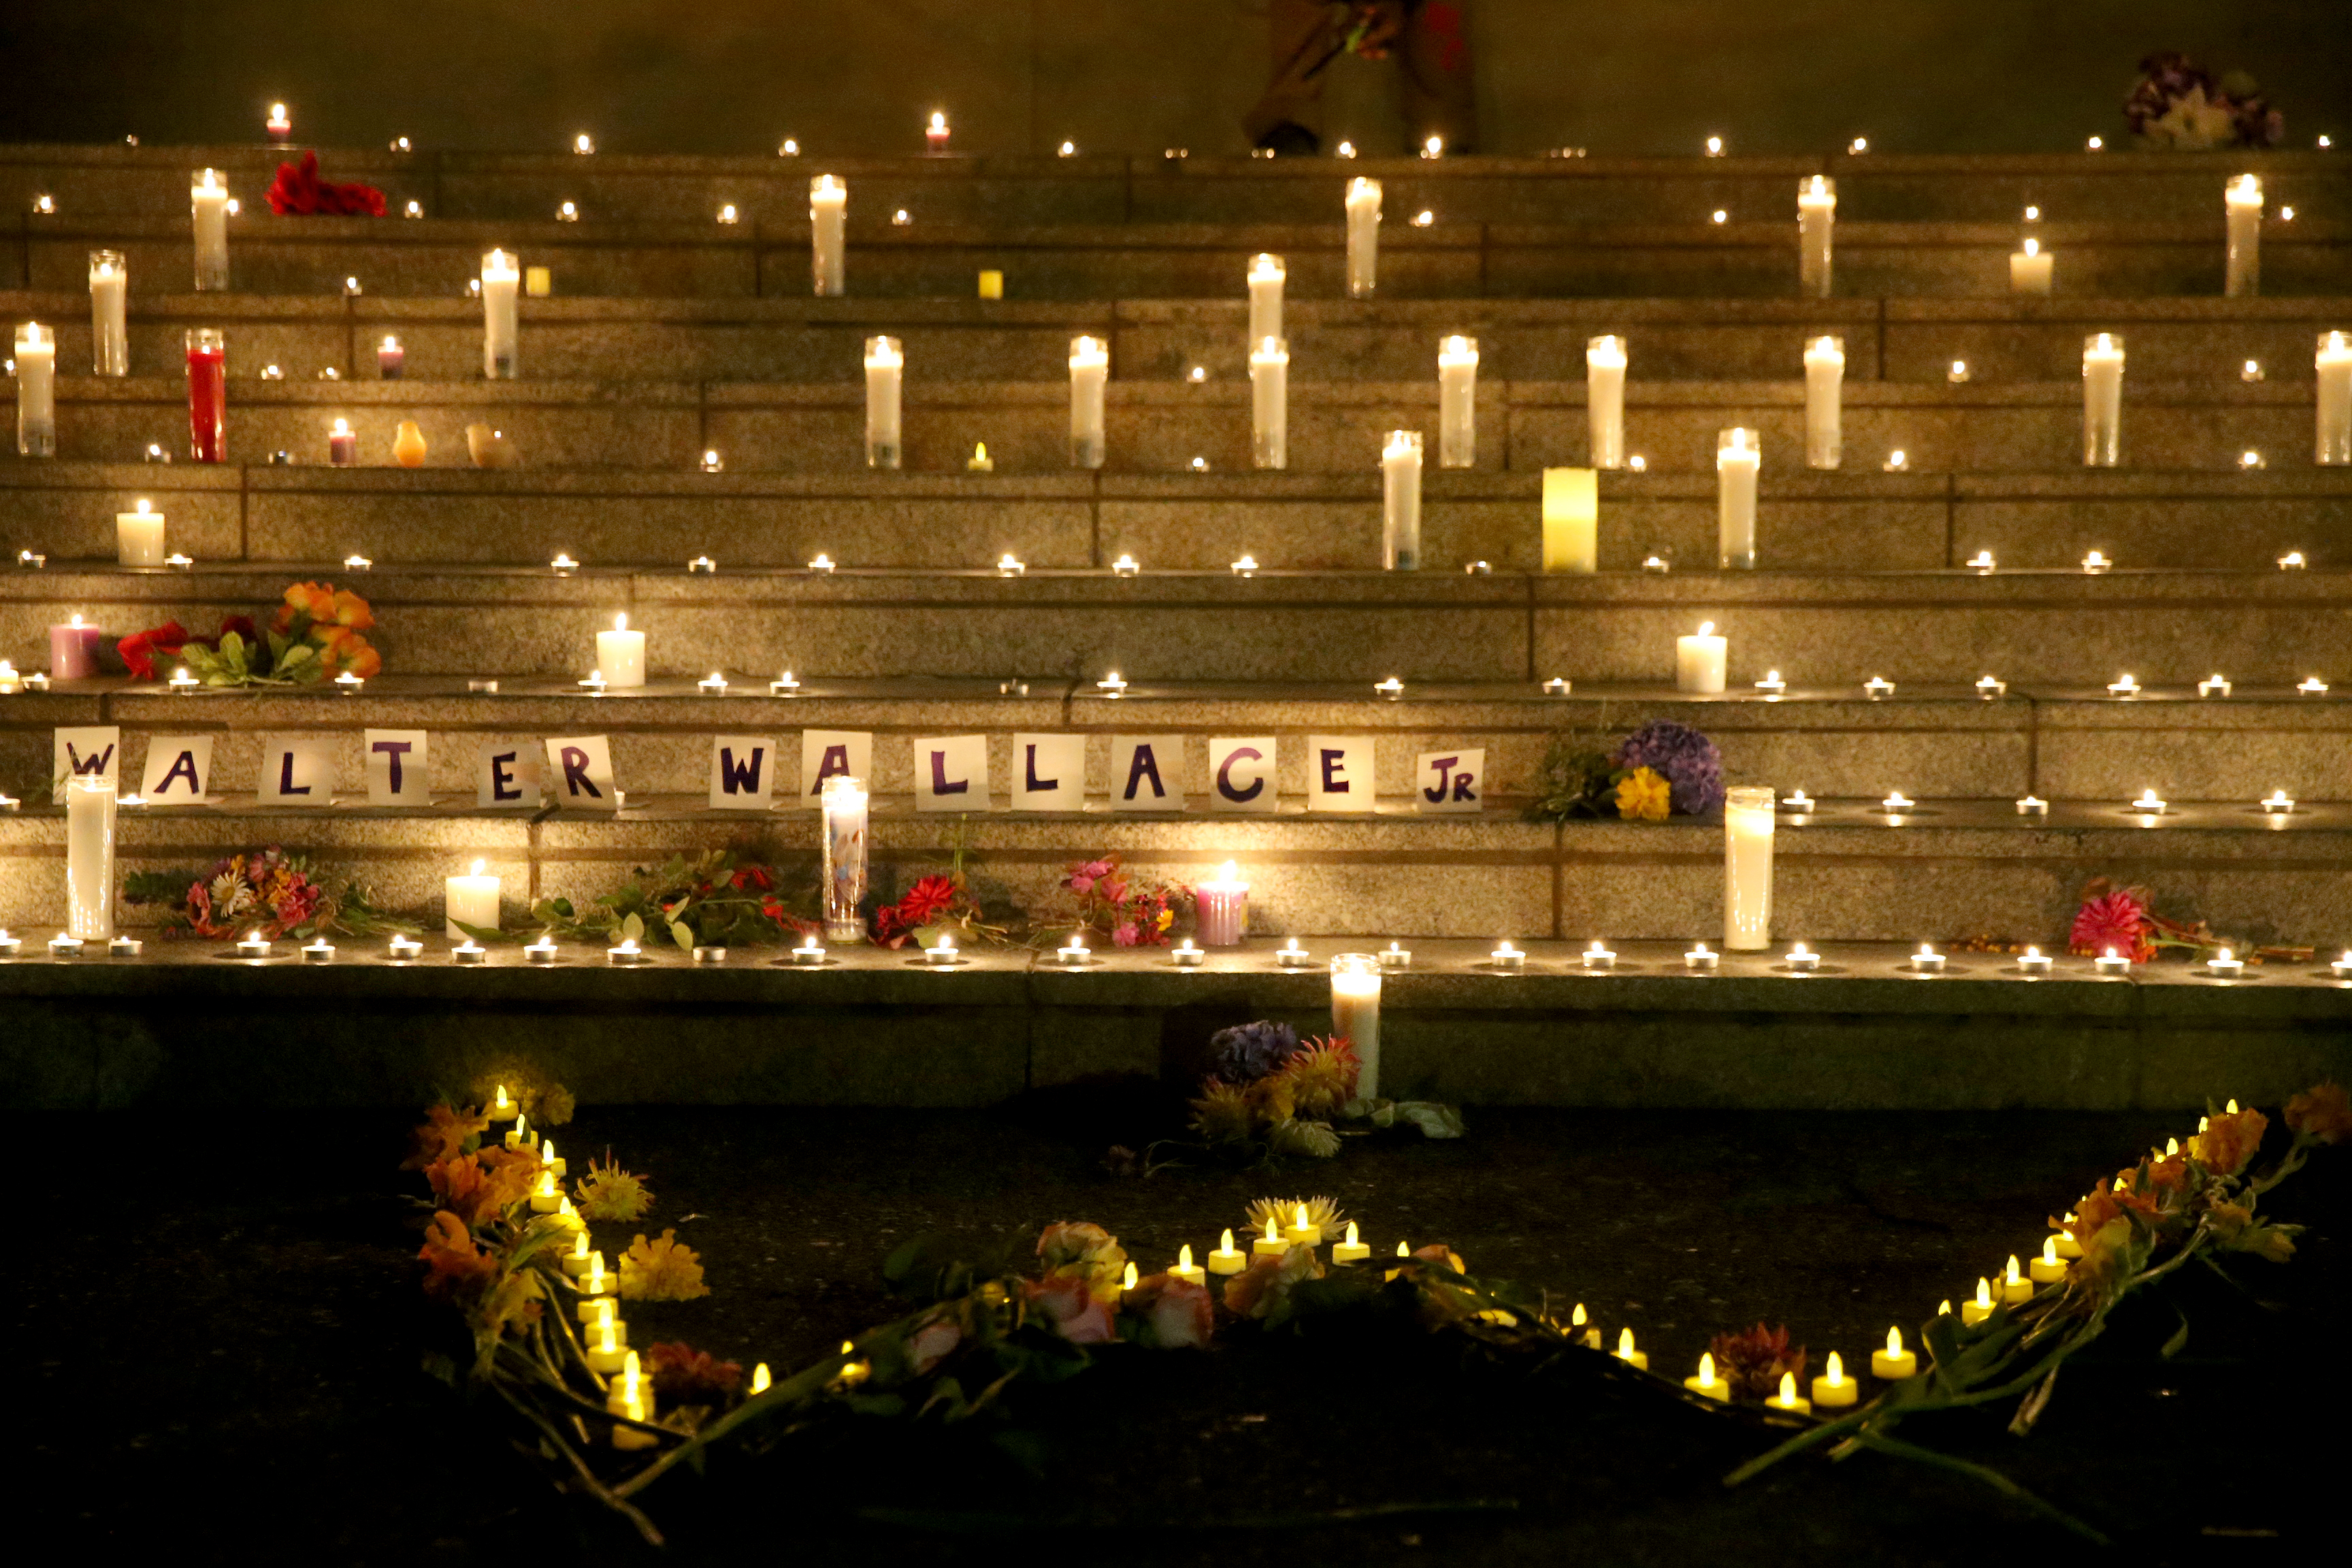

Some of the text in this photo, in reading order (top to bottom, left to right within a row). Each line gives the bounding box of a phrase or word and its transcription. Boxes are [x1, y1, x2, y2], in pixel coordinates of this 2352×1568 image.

[67, 741, 1476, 803] WALTER WALLACE JR
